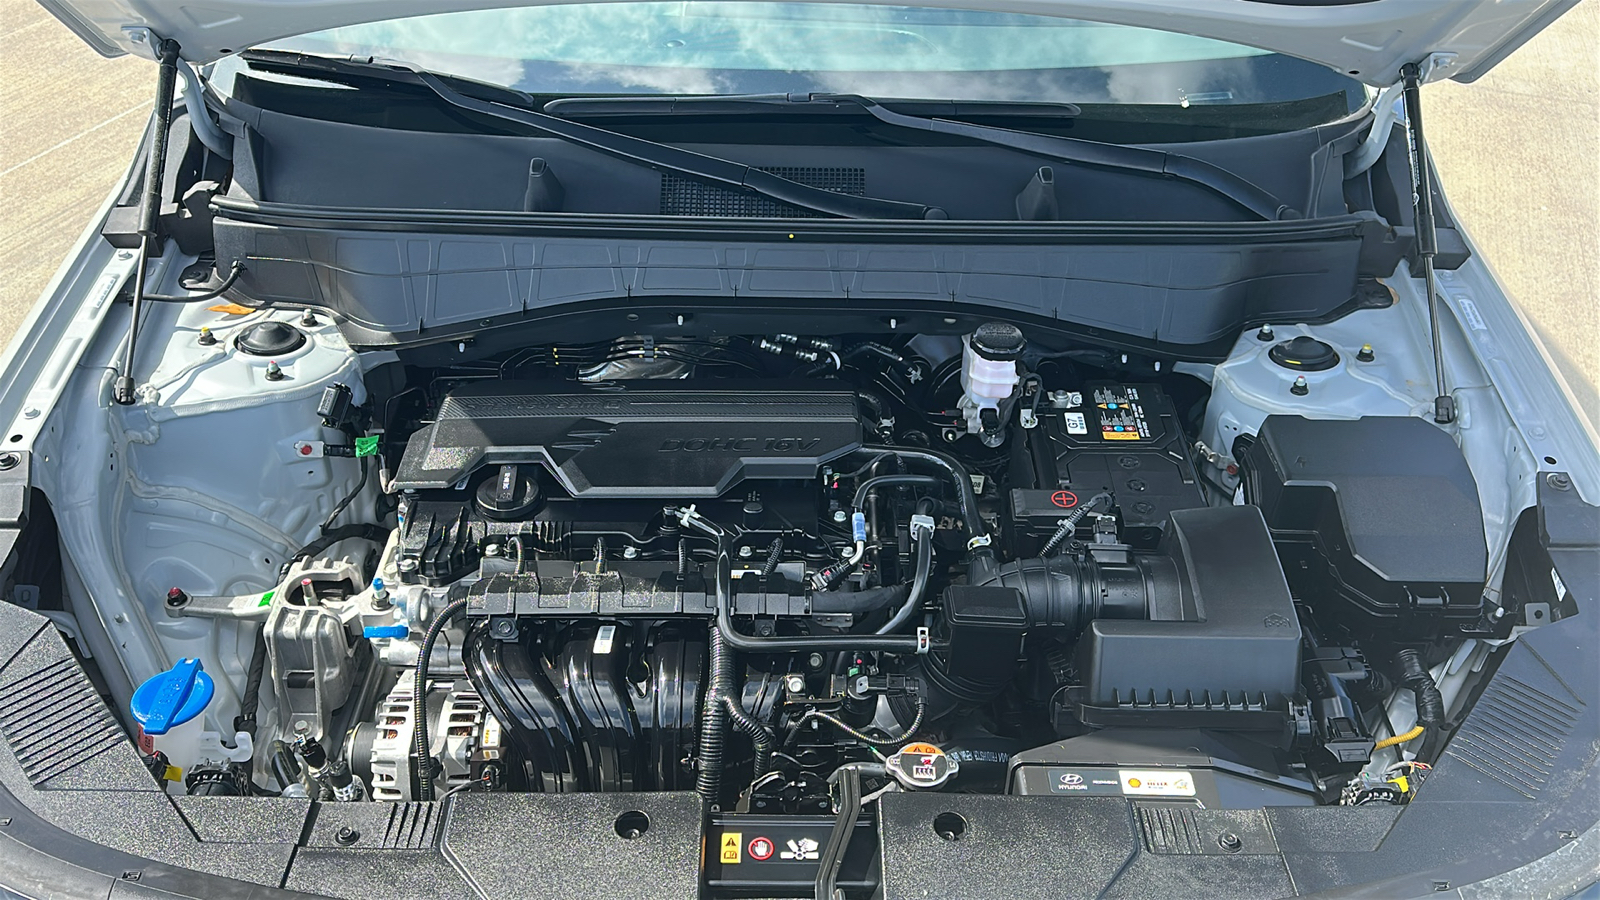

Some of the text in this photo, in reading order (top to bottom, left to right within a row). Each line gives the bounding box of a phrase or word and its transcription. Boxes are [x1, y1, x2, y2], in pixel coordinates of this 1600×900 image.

[658, 437, 821, 453] DOHC 16V
[1058, 783, 1088, 791] HYUNDAI
